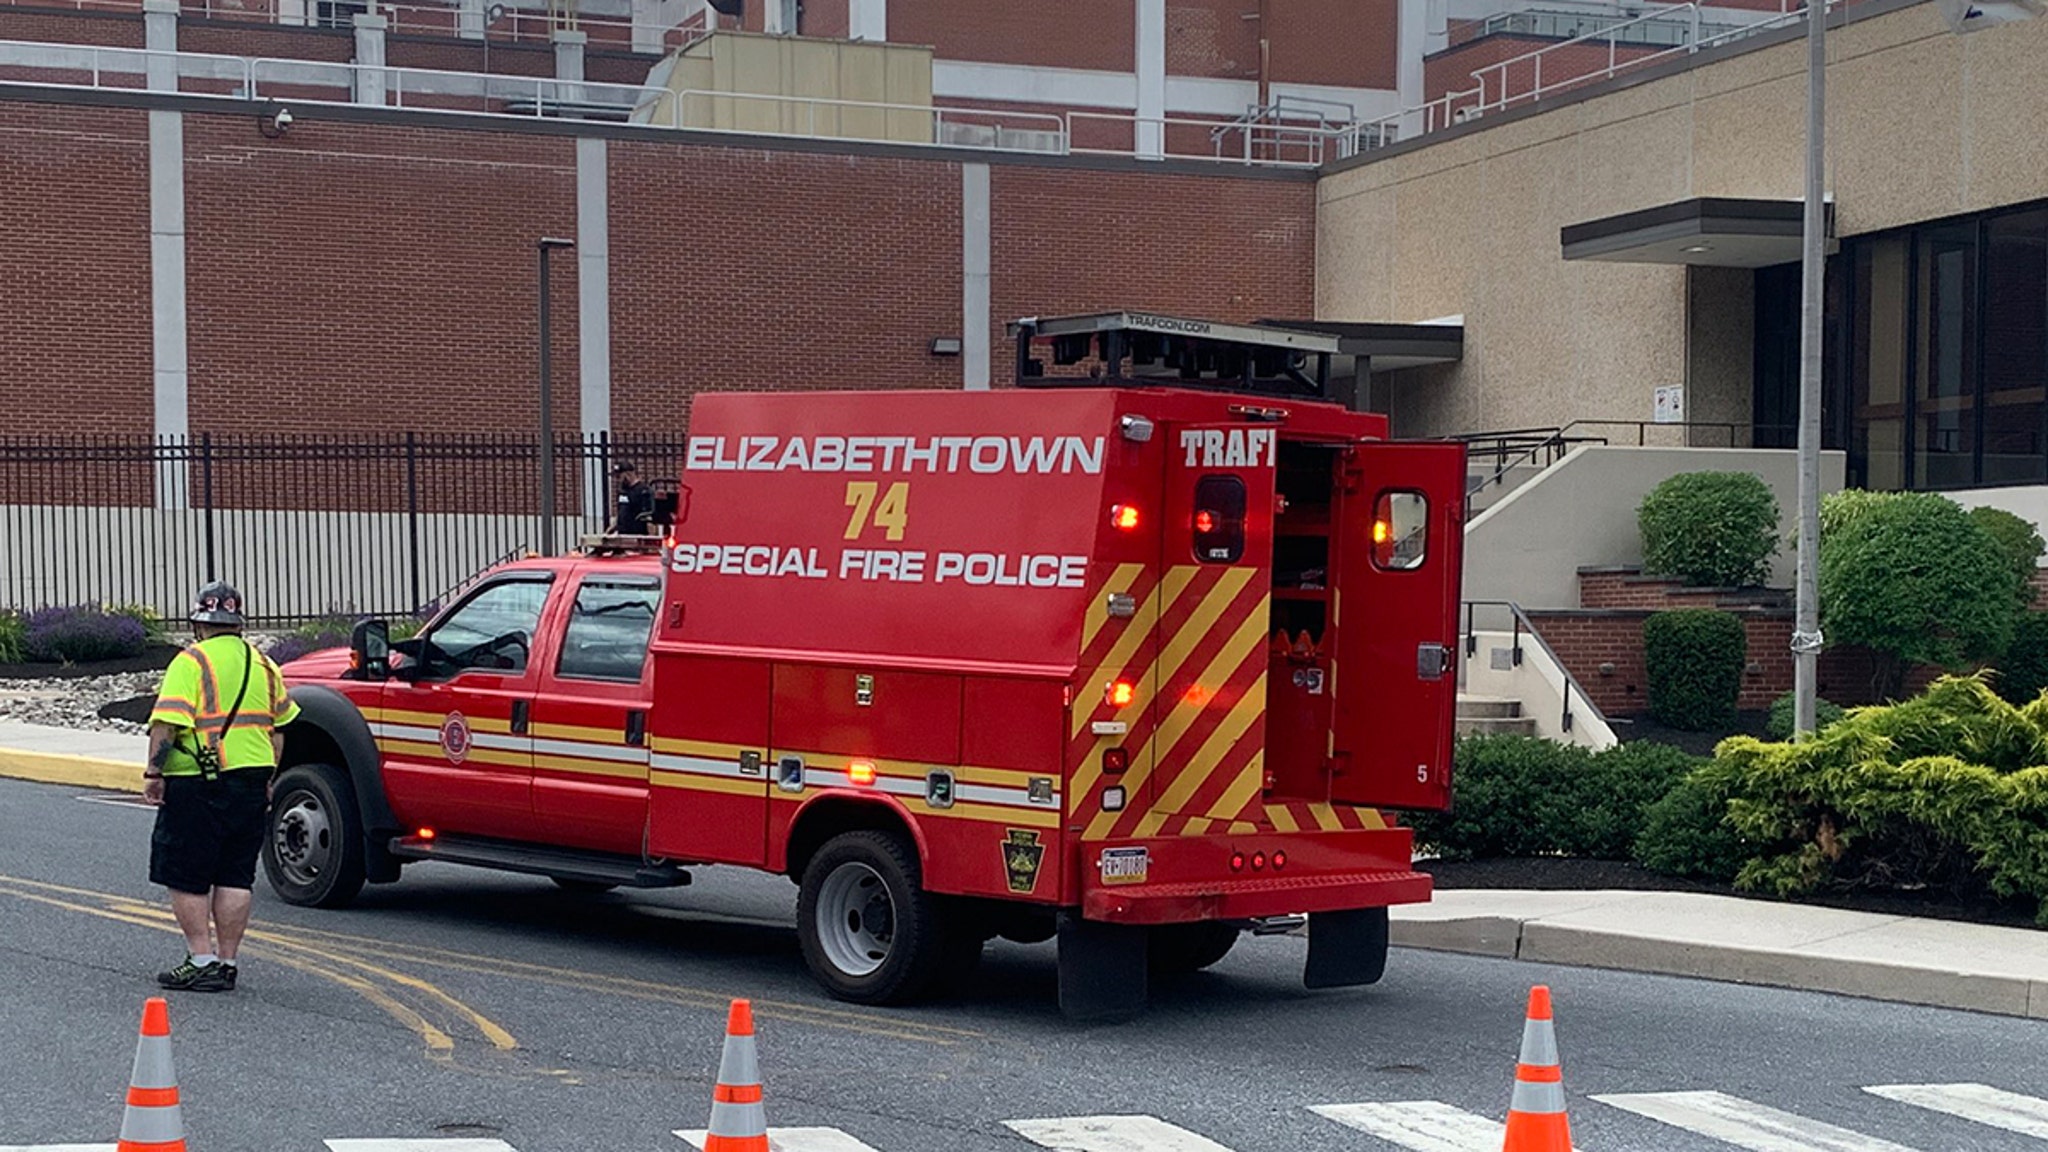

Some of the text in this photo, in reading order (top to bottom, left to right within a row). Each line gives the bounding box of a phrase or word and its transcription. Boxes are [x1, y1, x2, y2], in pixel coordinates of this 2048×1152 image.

[1128, 315, 1211, 334] TRAFCON.COM
[686, 436, 1106, 474] ELIZABETHTOWN
[843, 480, 910, 541] 74
[672, 544, 1089, 588] SPECIAL FIRE POLICE
[1417, 764, 1428, 783] 5
